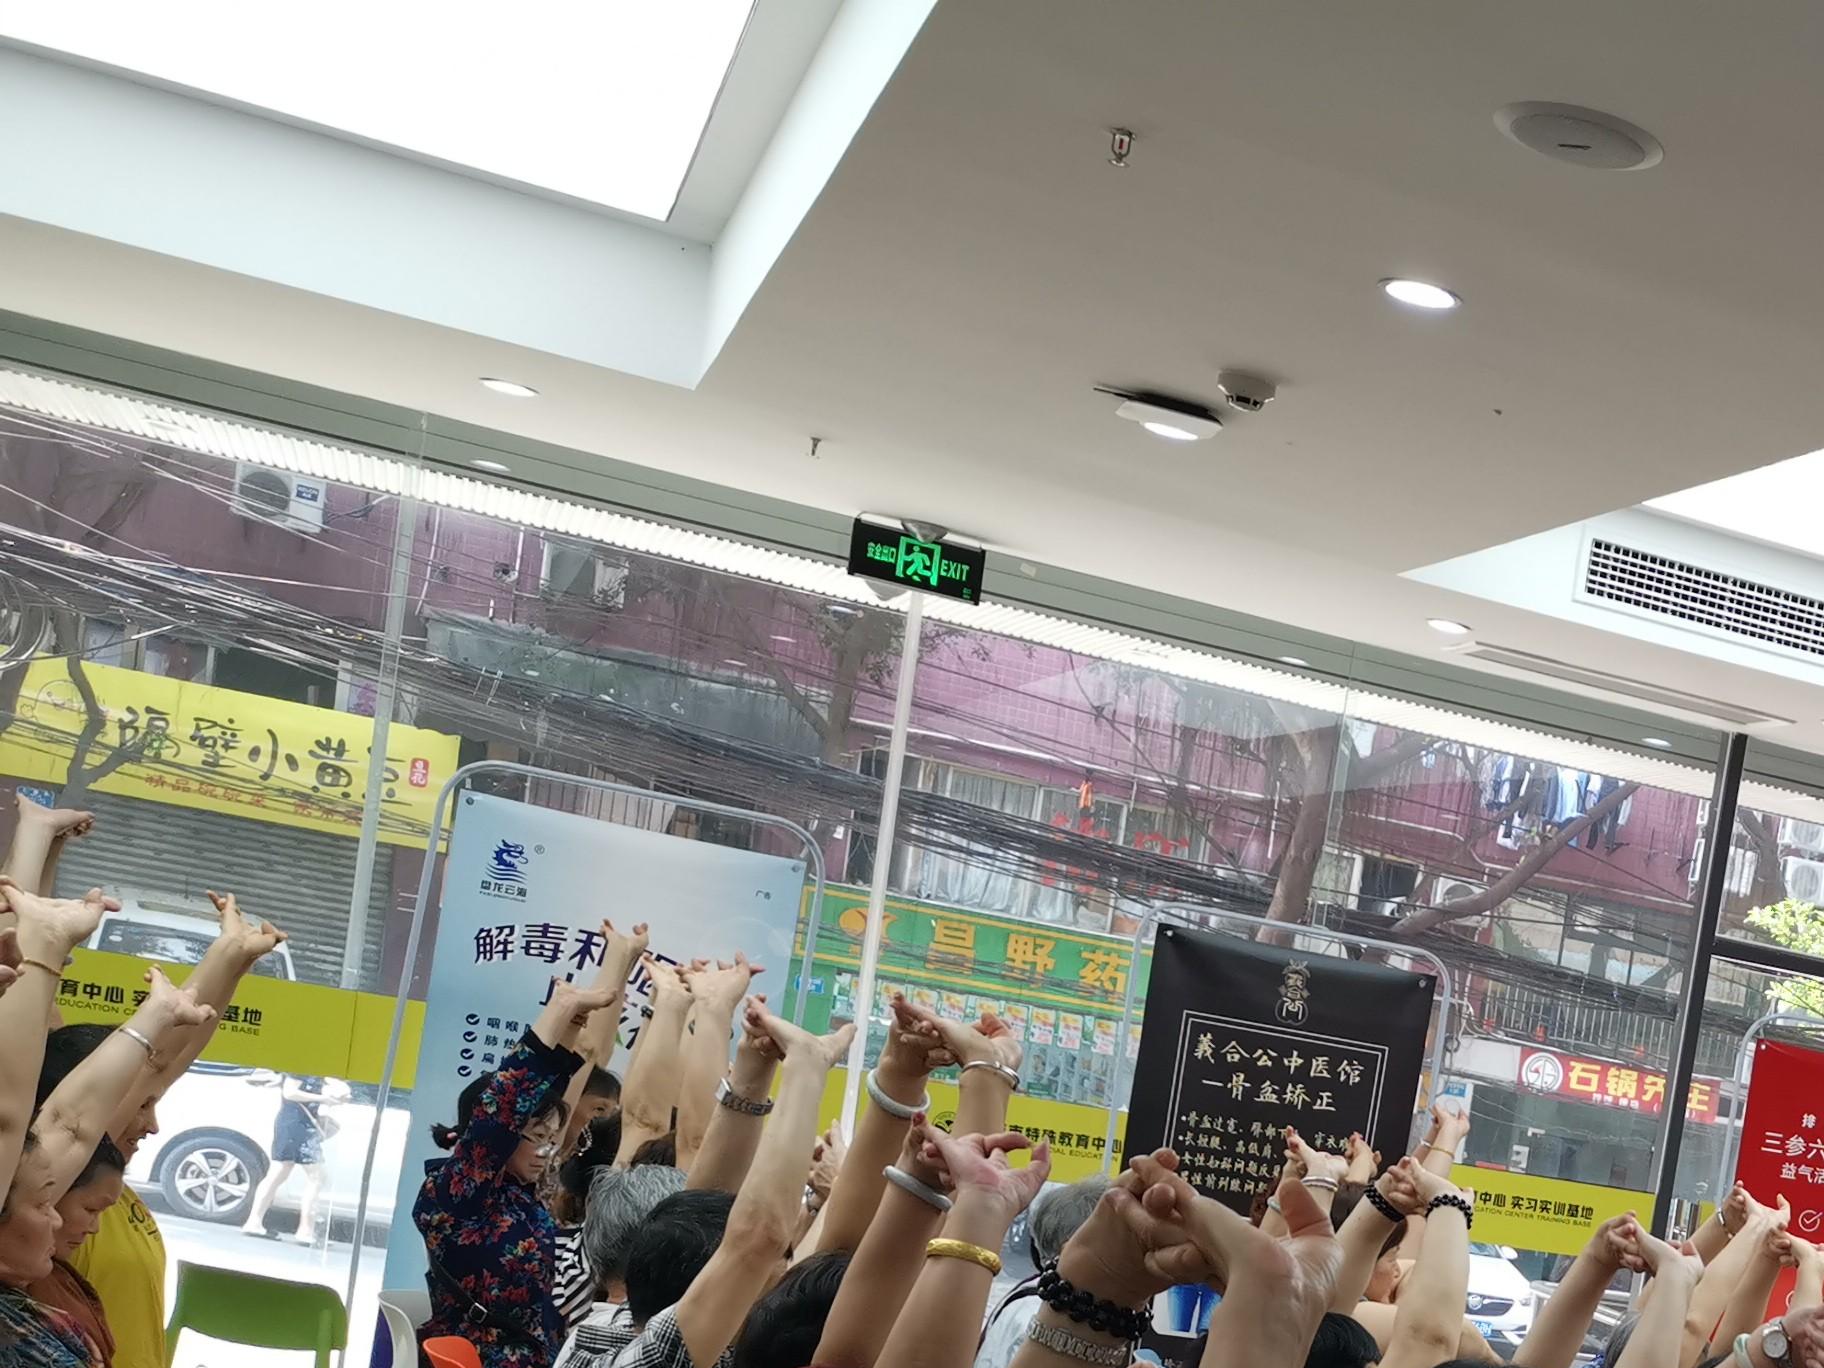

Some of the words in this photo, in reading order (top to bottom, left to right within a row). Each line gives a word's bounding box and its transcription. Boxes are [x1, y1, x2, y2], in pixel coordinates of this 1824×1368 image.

[940, 559, 970, 581] EXIT
[1511, 1195, 1595, 1221] 实习实训基地
